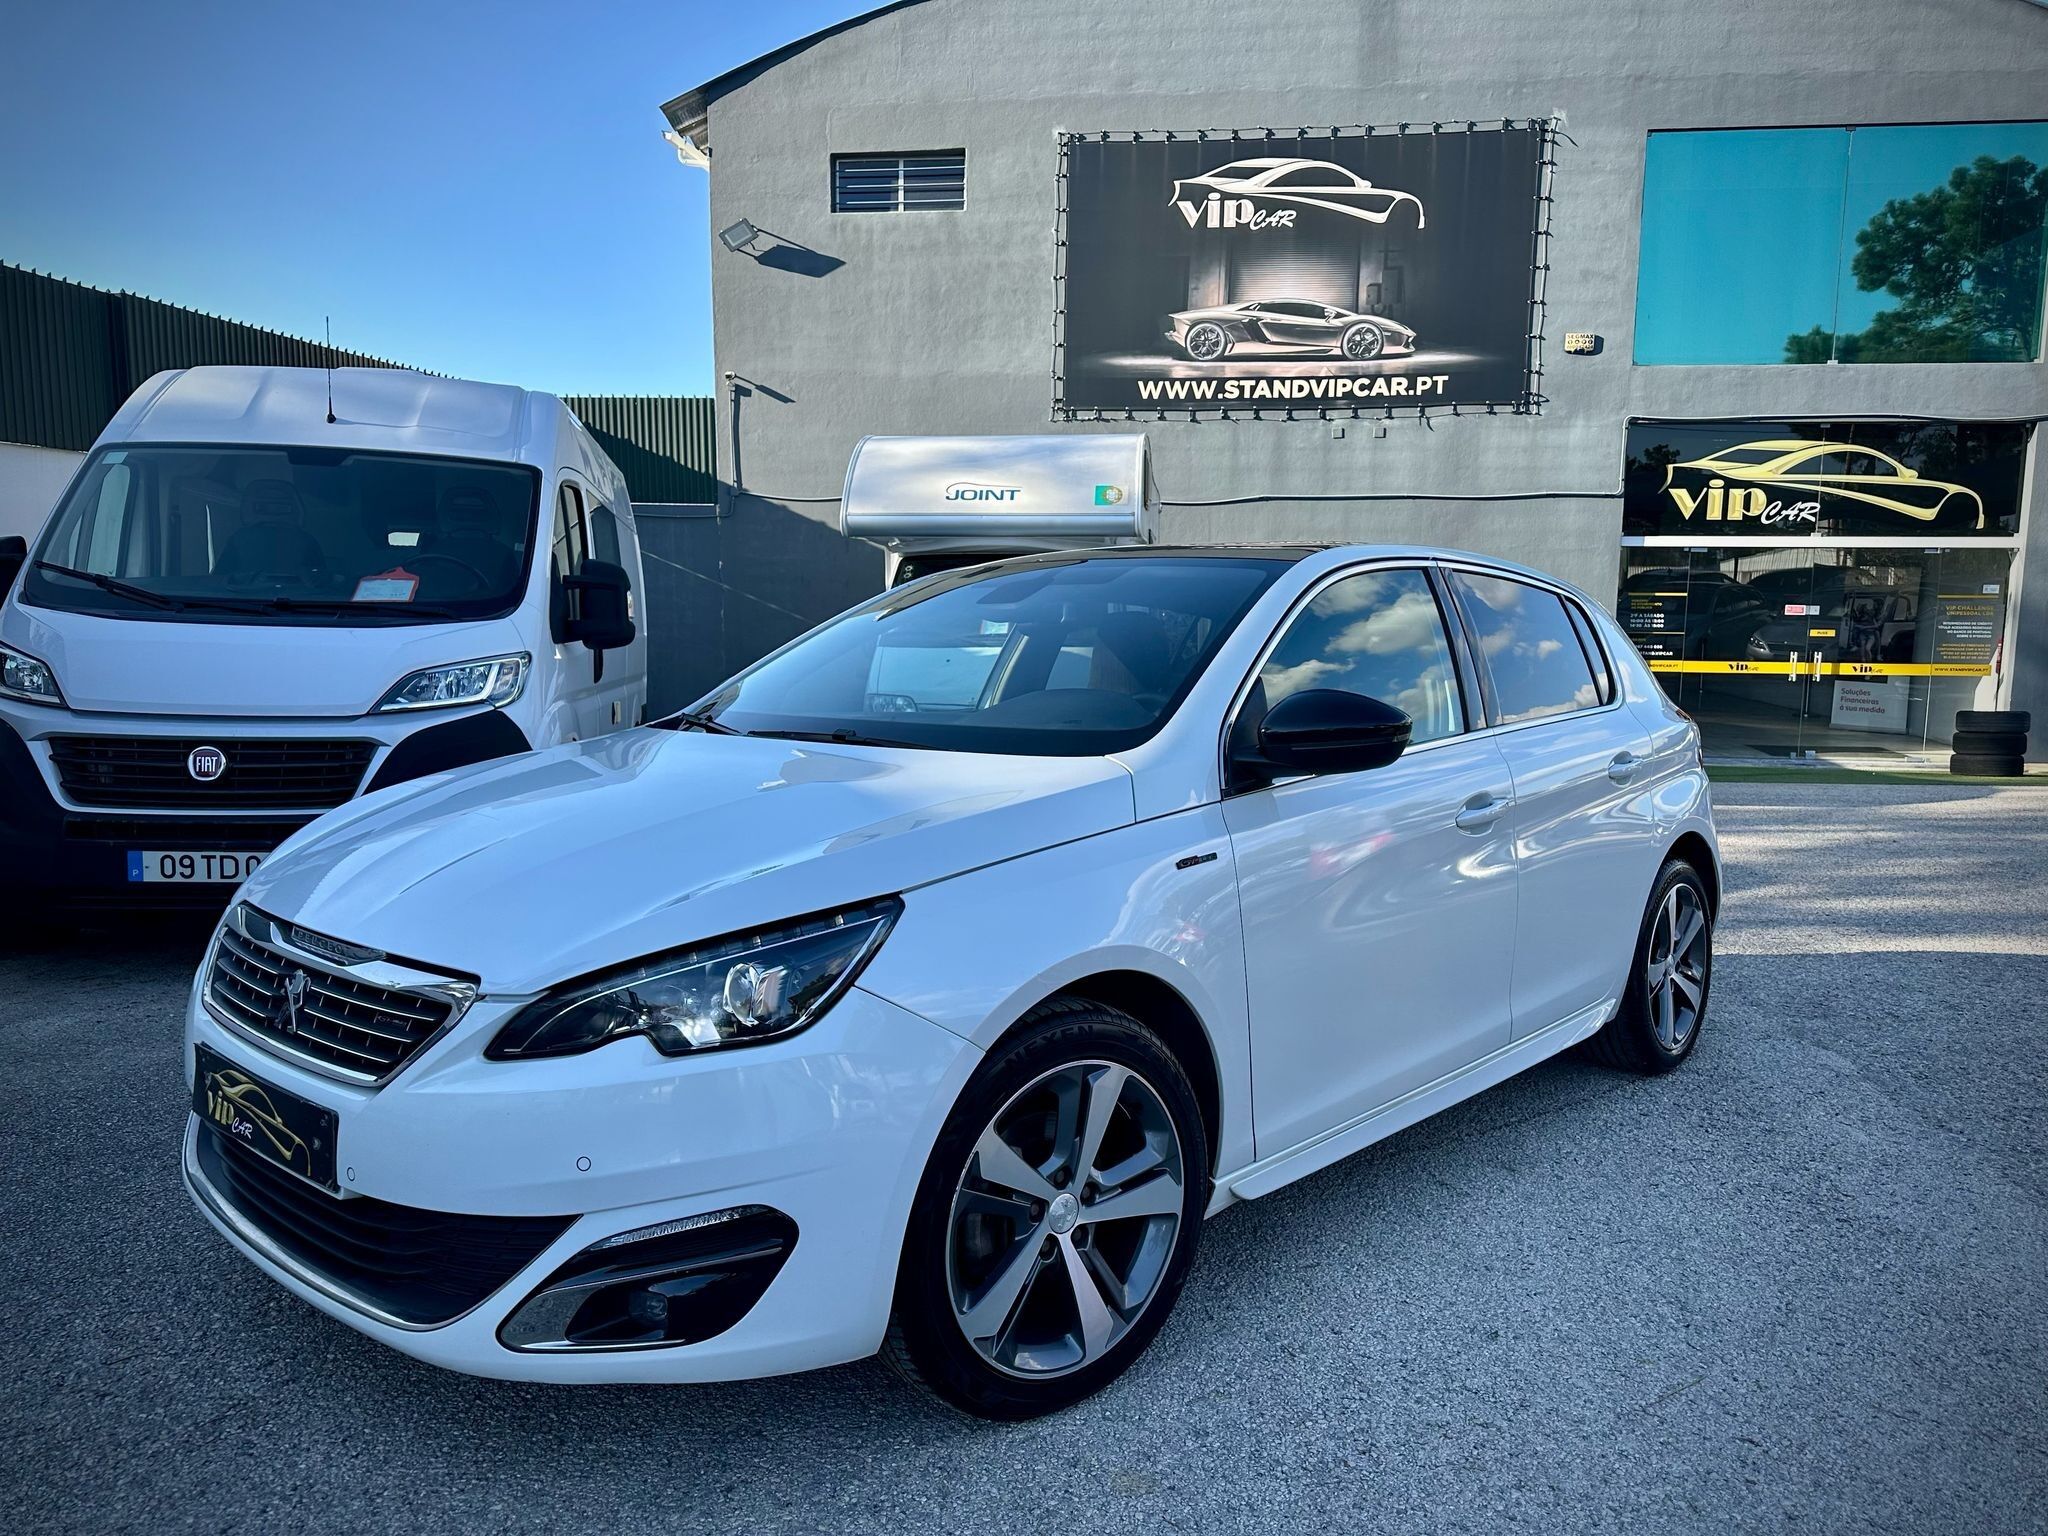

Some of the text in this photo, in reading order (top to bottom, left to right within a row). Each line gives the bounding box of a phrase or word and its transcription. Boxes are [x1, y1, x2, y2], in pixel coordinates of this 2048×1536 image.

[1249, 209, 1297, 231] CAR
[1137, 375, 1449, 400] WWW.STANDVIPCAR.PT
[945, 489, 1021, 501] JOINT
[1760, 500, 1821, 525] CAR
[1840, 687, 1871, 697] Soluções
[1840, 696, 1879, 705] Financeiras
[1858, 705, 1885, 714] medida
[196, 756, 218, 772] FIAT
[231, 1116, 254, 1140] CAR
